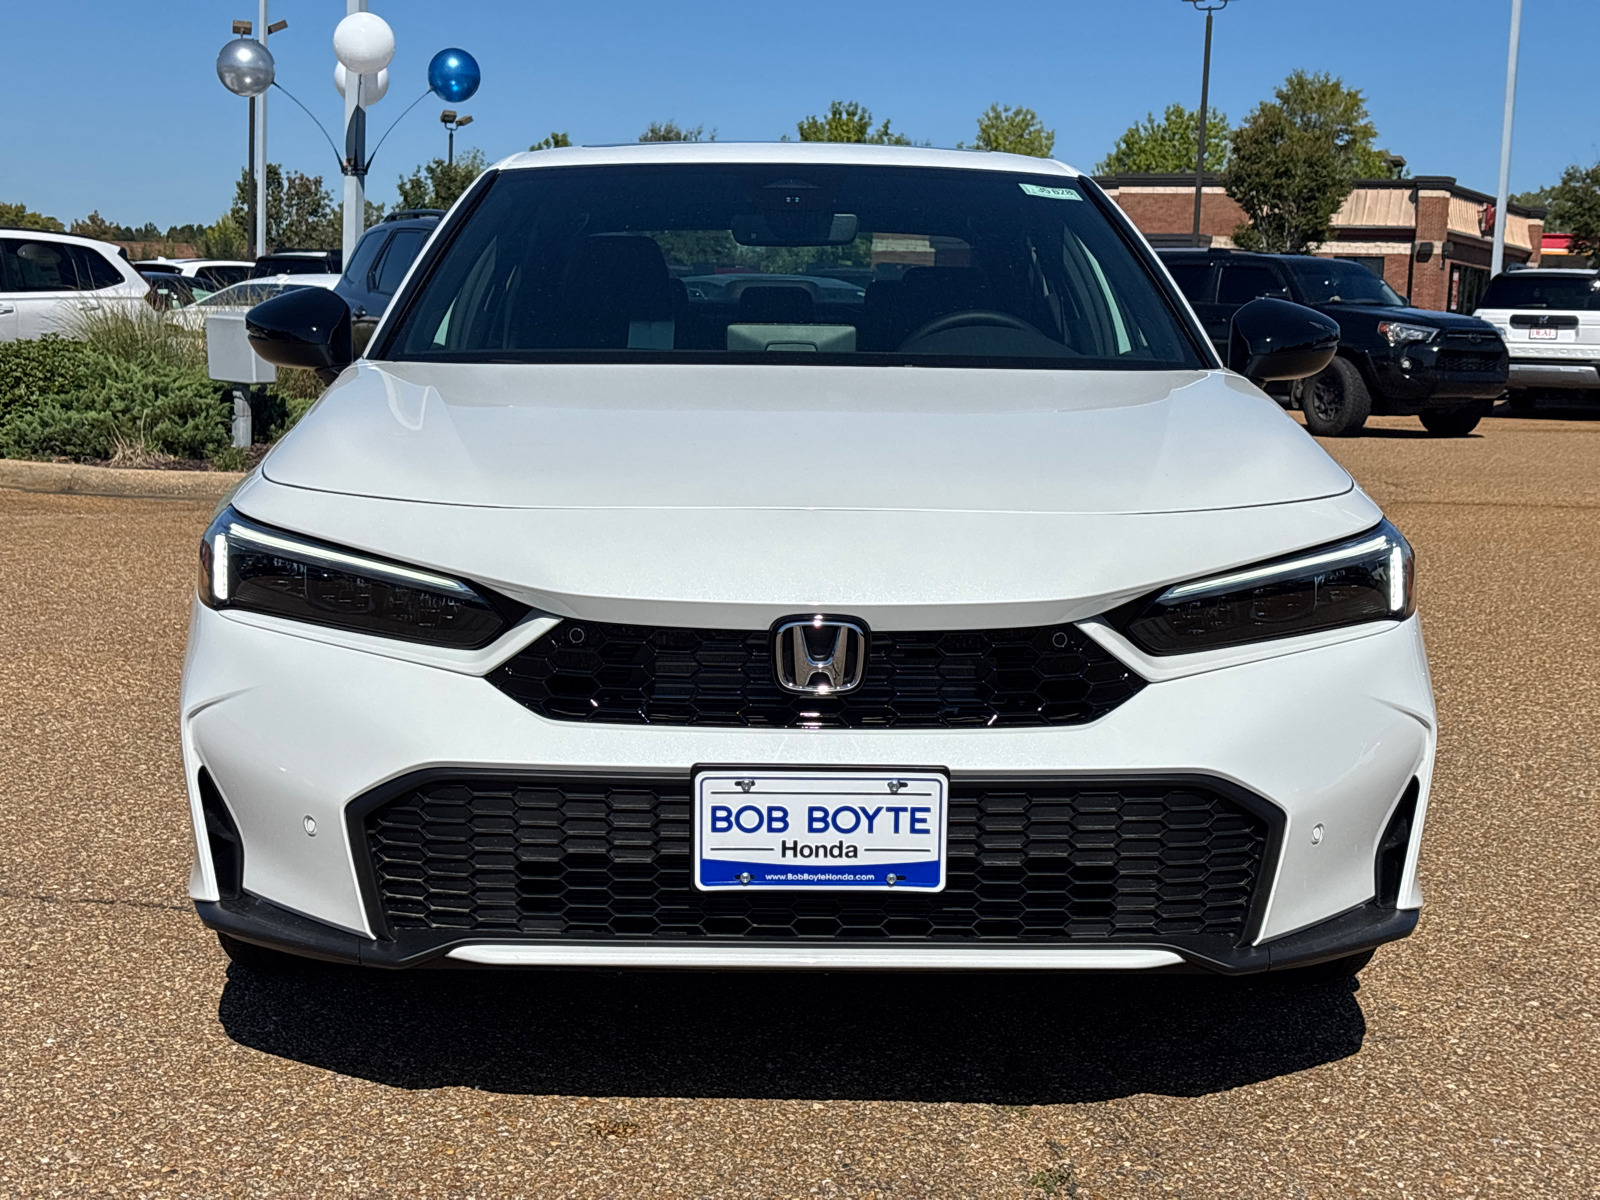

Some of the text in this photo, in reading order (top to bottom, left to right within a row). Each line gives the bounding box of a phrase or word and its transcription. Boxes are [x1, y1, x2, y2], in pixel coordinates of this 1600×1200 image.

[710, 805, 932, 834] BOB BOYTE
[780, 839, 858, 859] Honda
[765, 872, 875, 883] www.BobBoyteHonda.com
